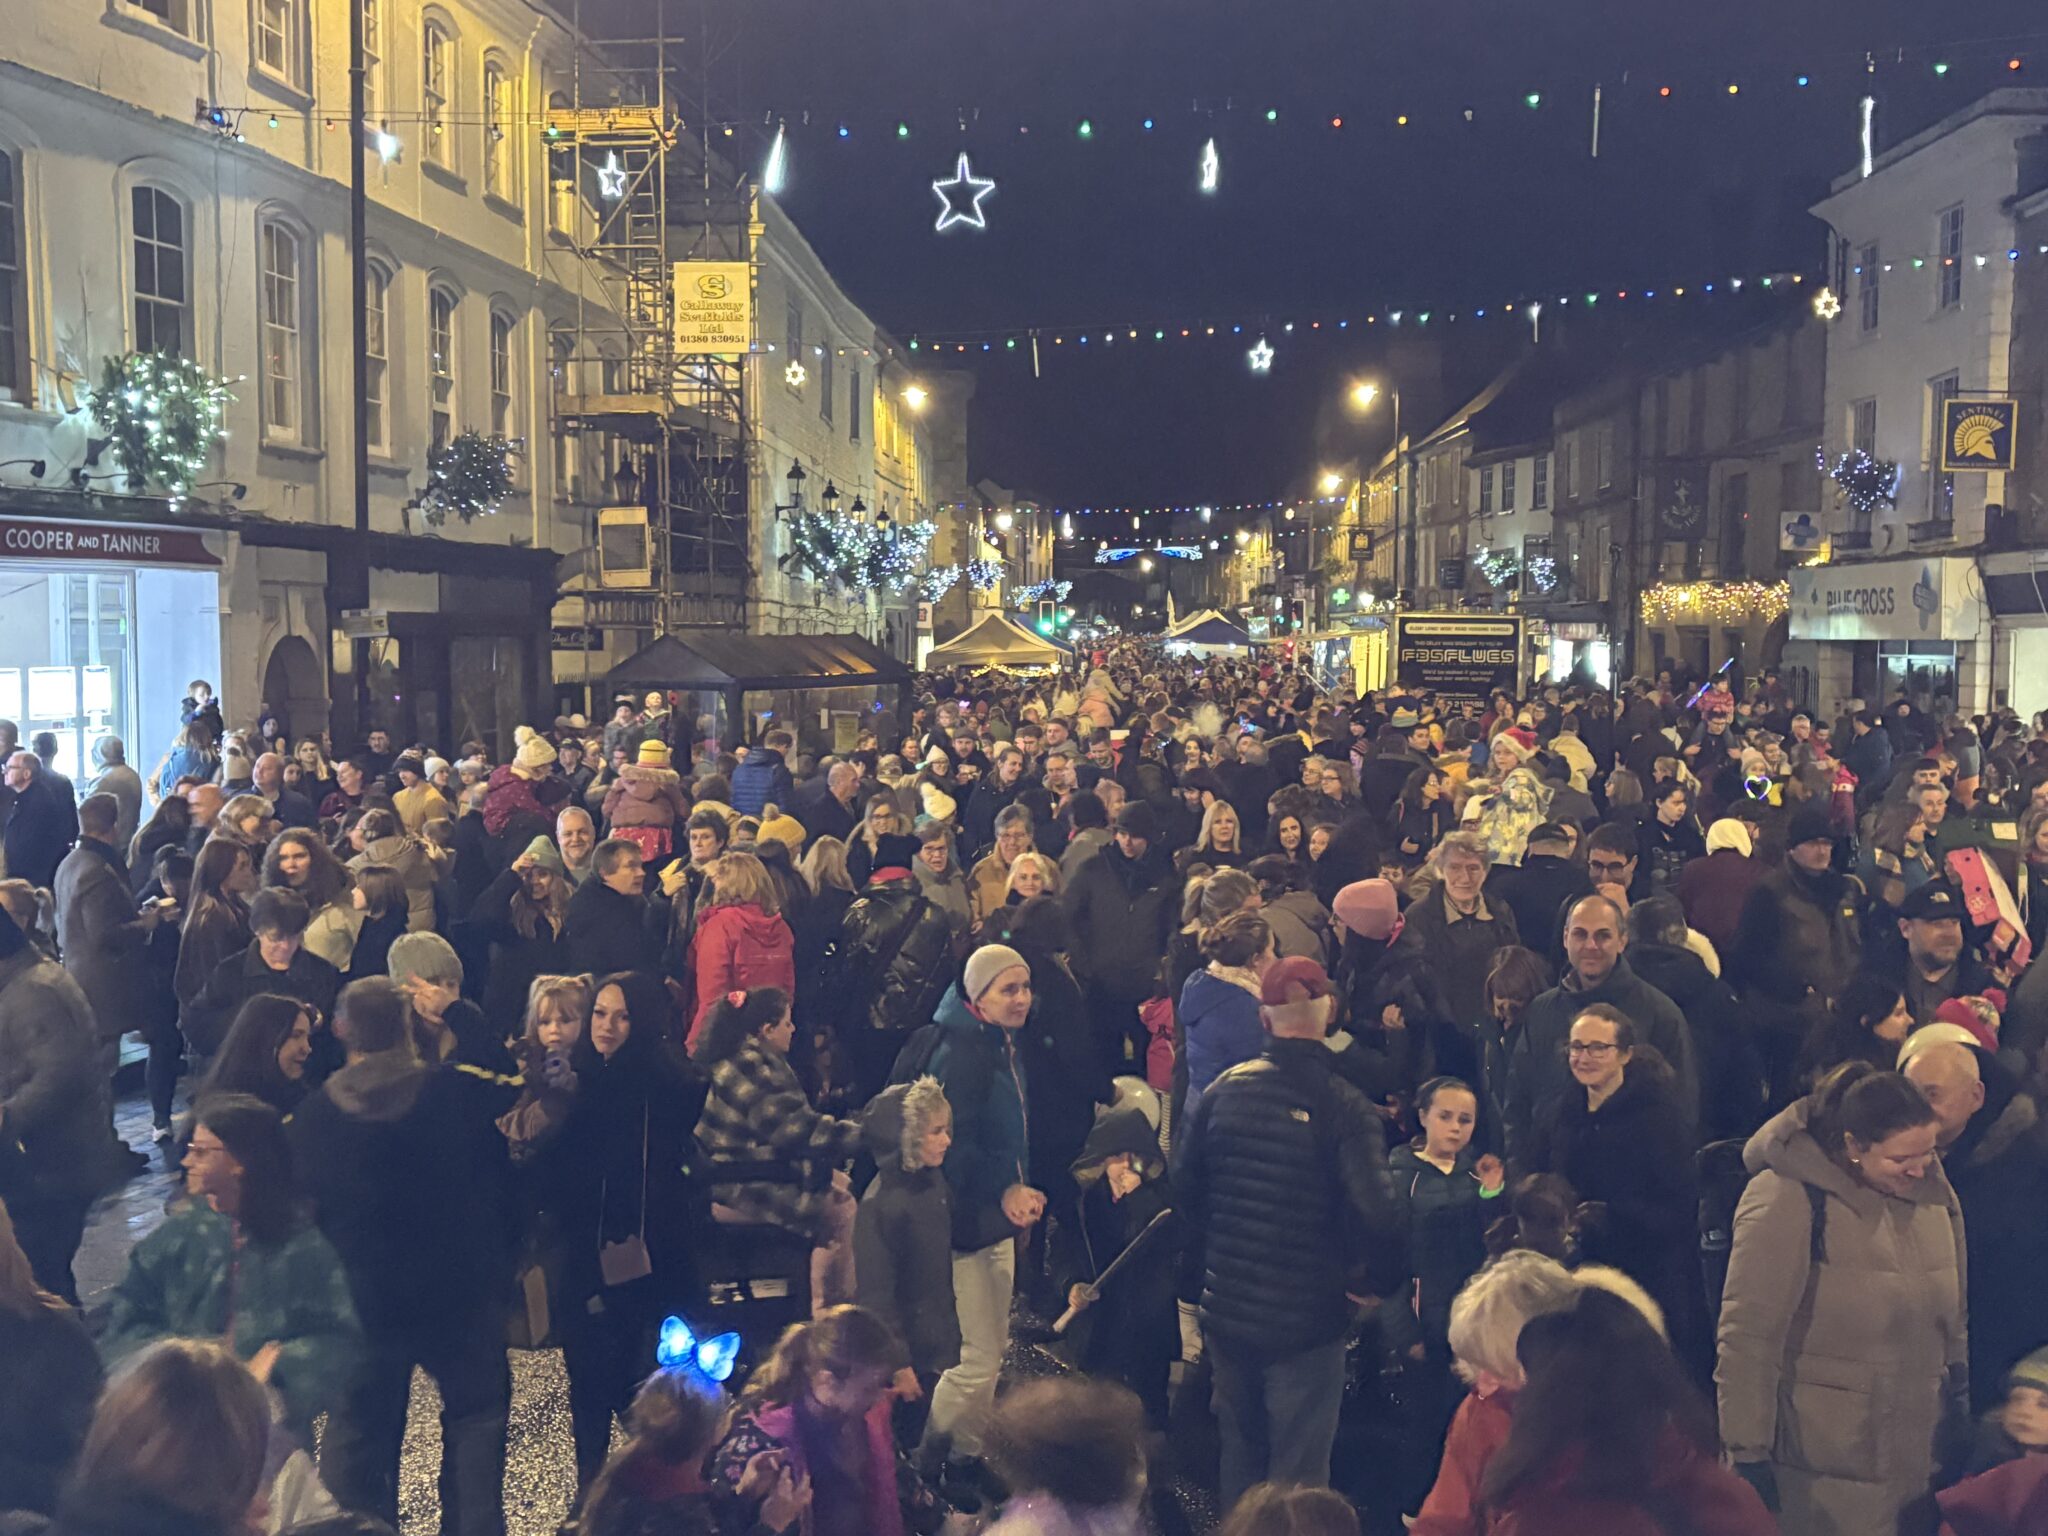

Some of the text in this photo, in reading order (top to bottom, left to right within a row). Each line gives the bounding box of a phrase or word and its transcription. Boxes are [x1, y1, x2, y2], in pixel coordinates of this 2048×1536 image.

[680, 300, 744, 312] Callaway
[680, 312, 744, 322] Scaffolds
[699, 324, 724, 334] Ltd
[680, 335, 708, 343] 01380
[6, 528, 160, 554] COOPER AND TANNER
